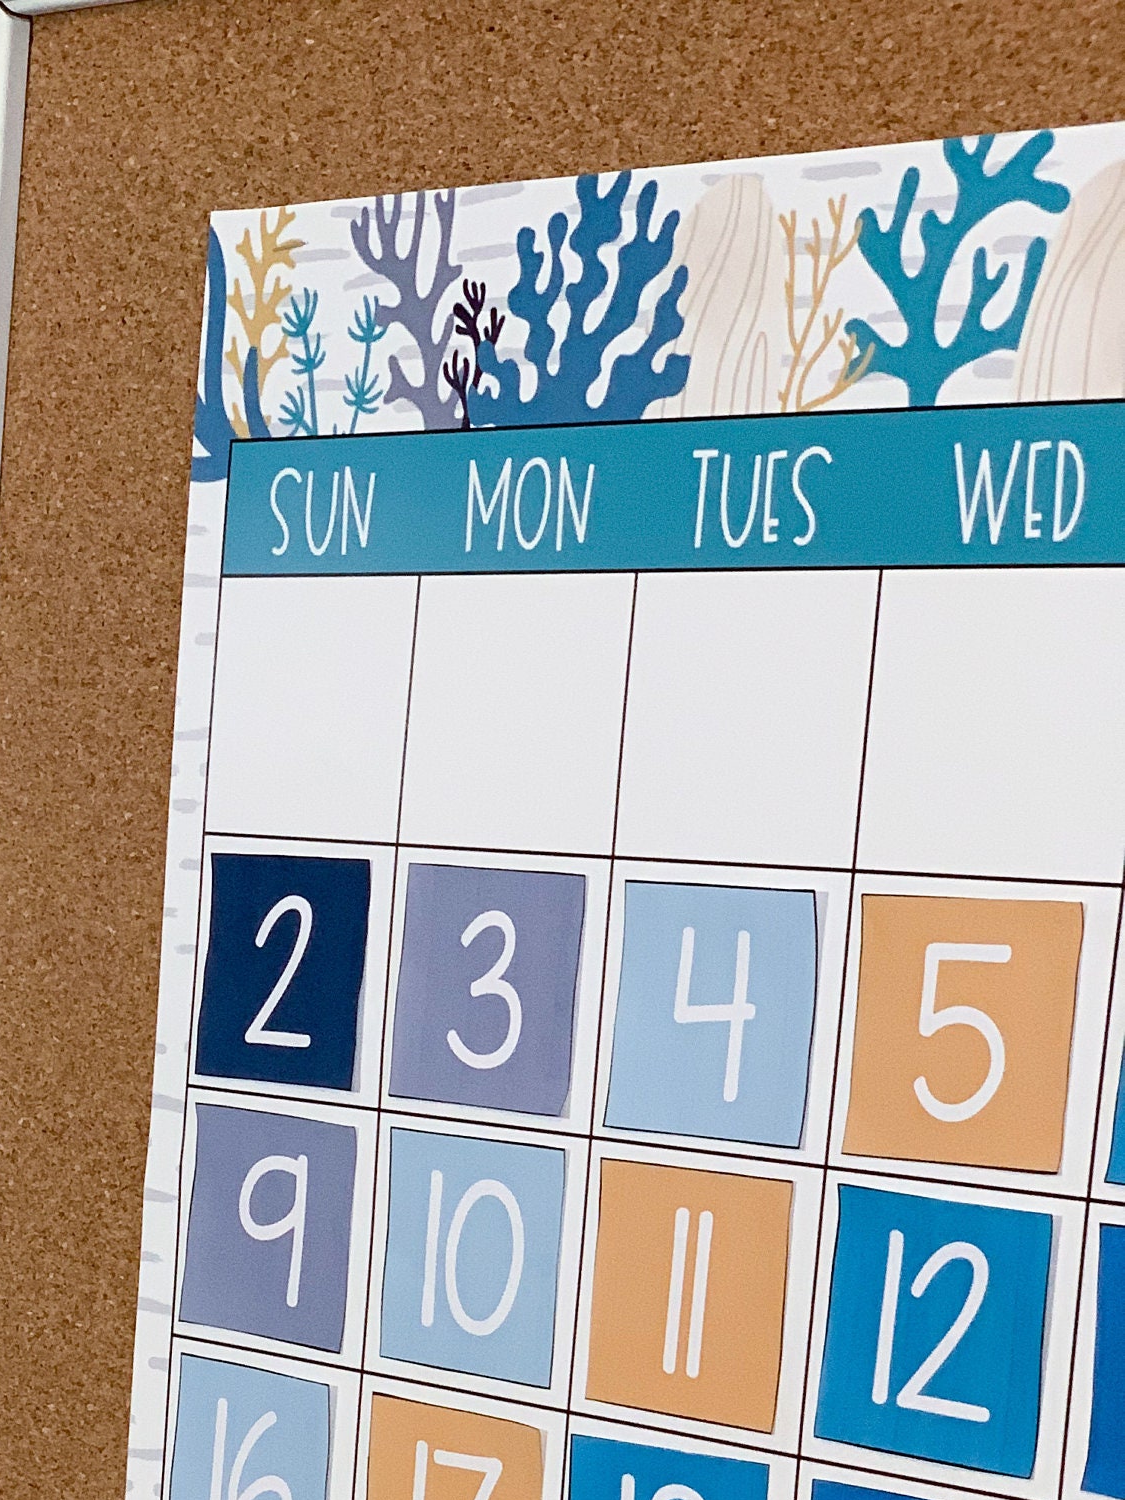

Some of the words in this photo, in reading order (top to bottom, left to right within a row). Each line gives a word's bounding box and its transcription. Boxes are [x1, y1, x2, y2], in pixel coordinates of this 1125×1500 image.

[269, 465, 377, 557] SUN
[465, 456, 596, 553] MON
[692, 445, 833, 549] TUES
[953, 440, 1087, 546] WED
[244, 894, 314, 1049] 2
[446, 909, 523, 1070] 3
[673, 925, 757, 1103] 4
[912, 942, 1013, 1122] 5
[238, 1154, 308, 1308] 9
[421, 1168, 525, 1337] 10
[662, 1206, 714, 1379] 11
[872, 1230, 991, 1423] 12
